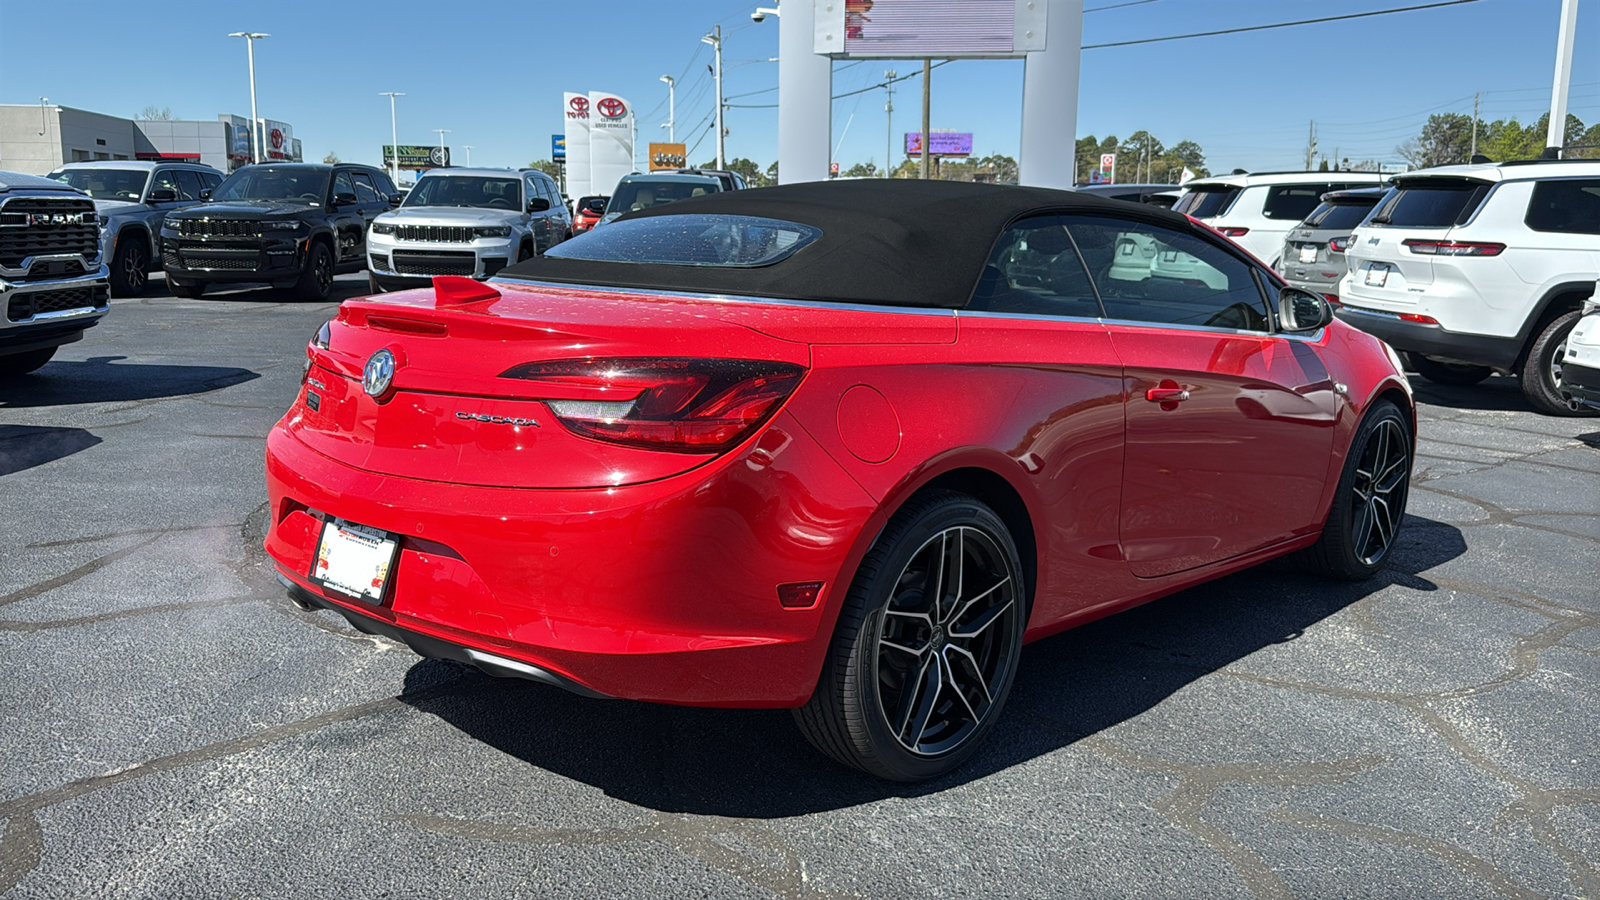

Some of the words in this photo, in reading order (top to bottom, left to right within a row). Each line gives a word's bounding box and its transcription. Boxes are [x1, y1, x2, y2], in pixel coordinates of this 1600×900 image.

[652, 151, 683, 165] Jeep
[31, 213, 82, 225] RAM
[455, 411, 541, 427] CASCADA
